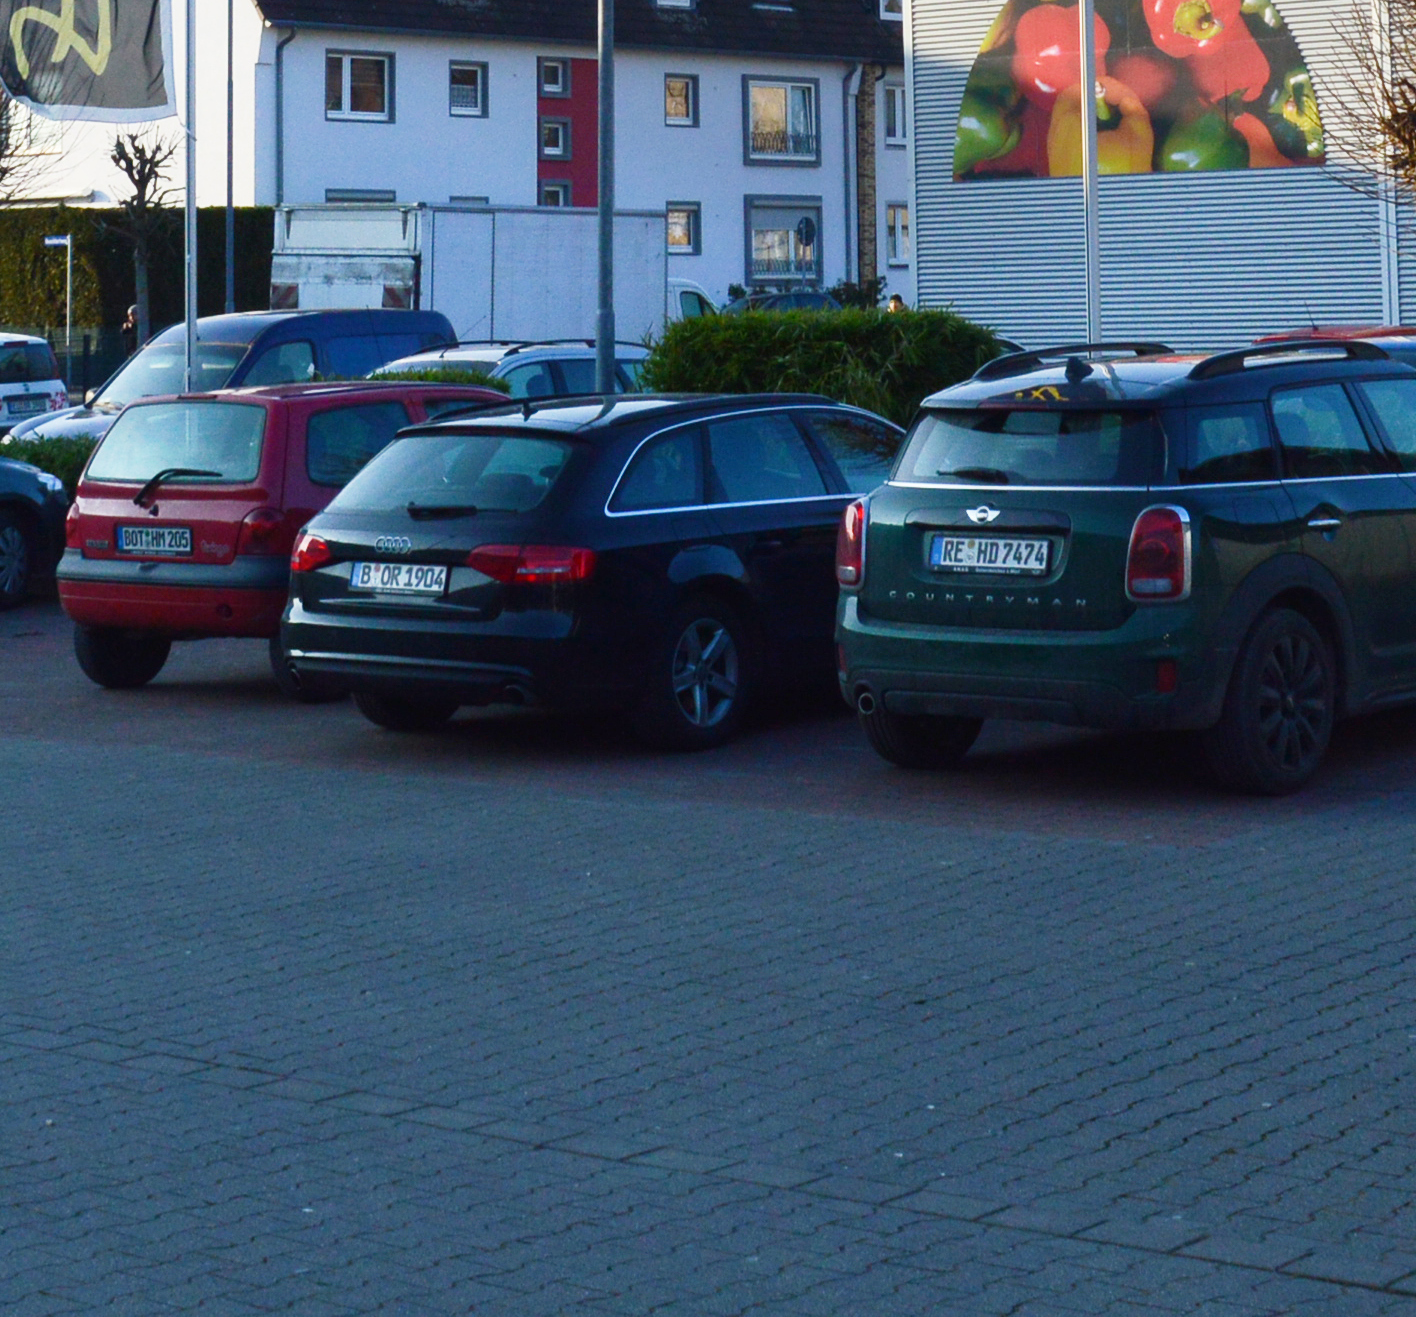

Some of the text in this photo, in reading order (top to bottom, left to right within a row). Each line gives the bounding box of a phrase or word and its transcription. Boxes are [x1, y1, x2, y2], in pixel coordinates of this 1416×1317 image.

[123, 529, 145, 548] BOT
[151, 531, 166, 548] HM
[168, 531, 190, 549] 205
[942, 540, 1045, 567] RE HD 7474
[360, 564, 445, 589] B OR 1904
[888, 590, 1088, 607] COUNTRYMAN
